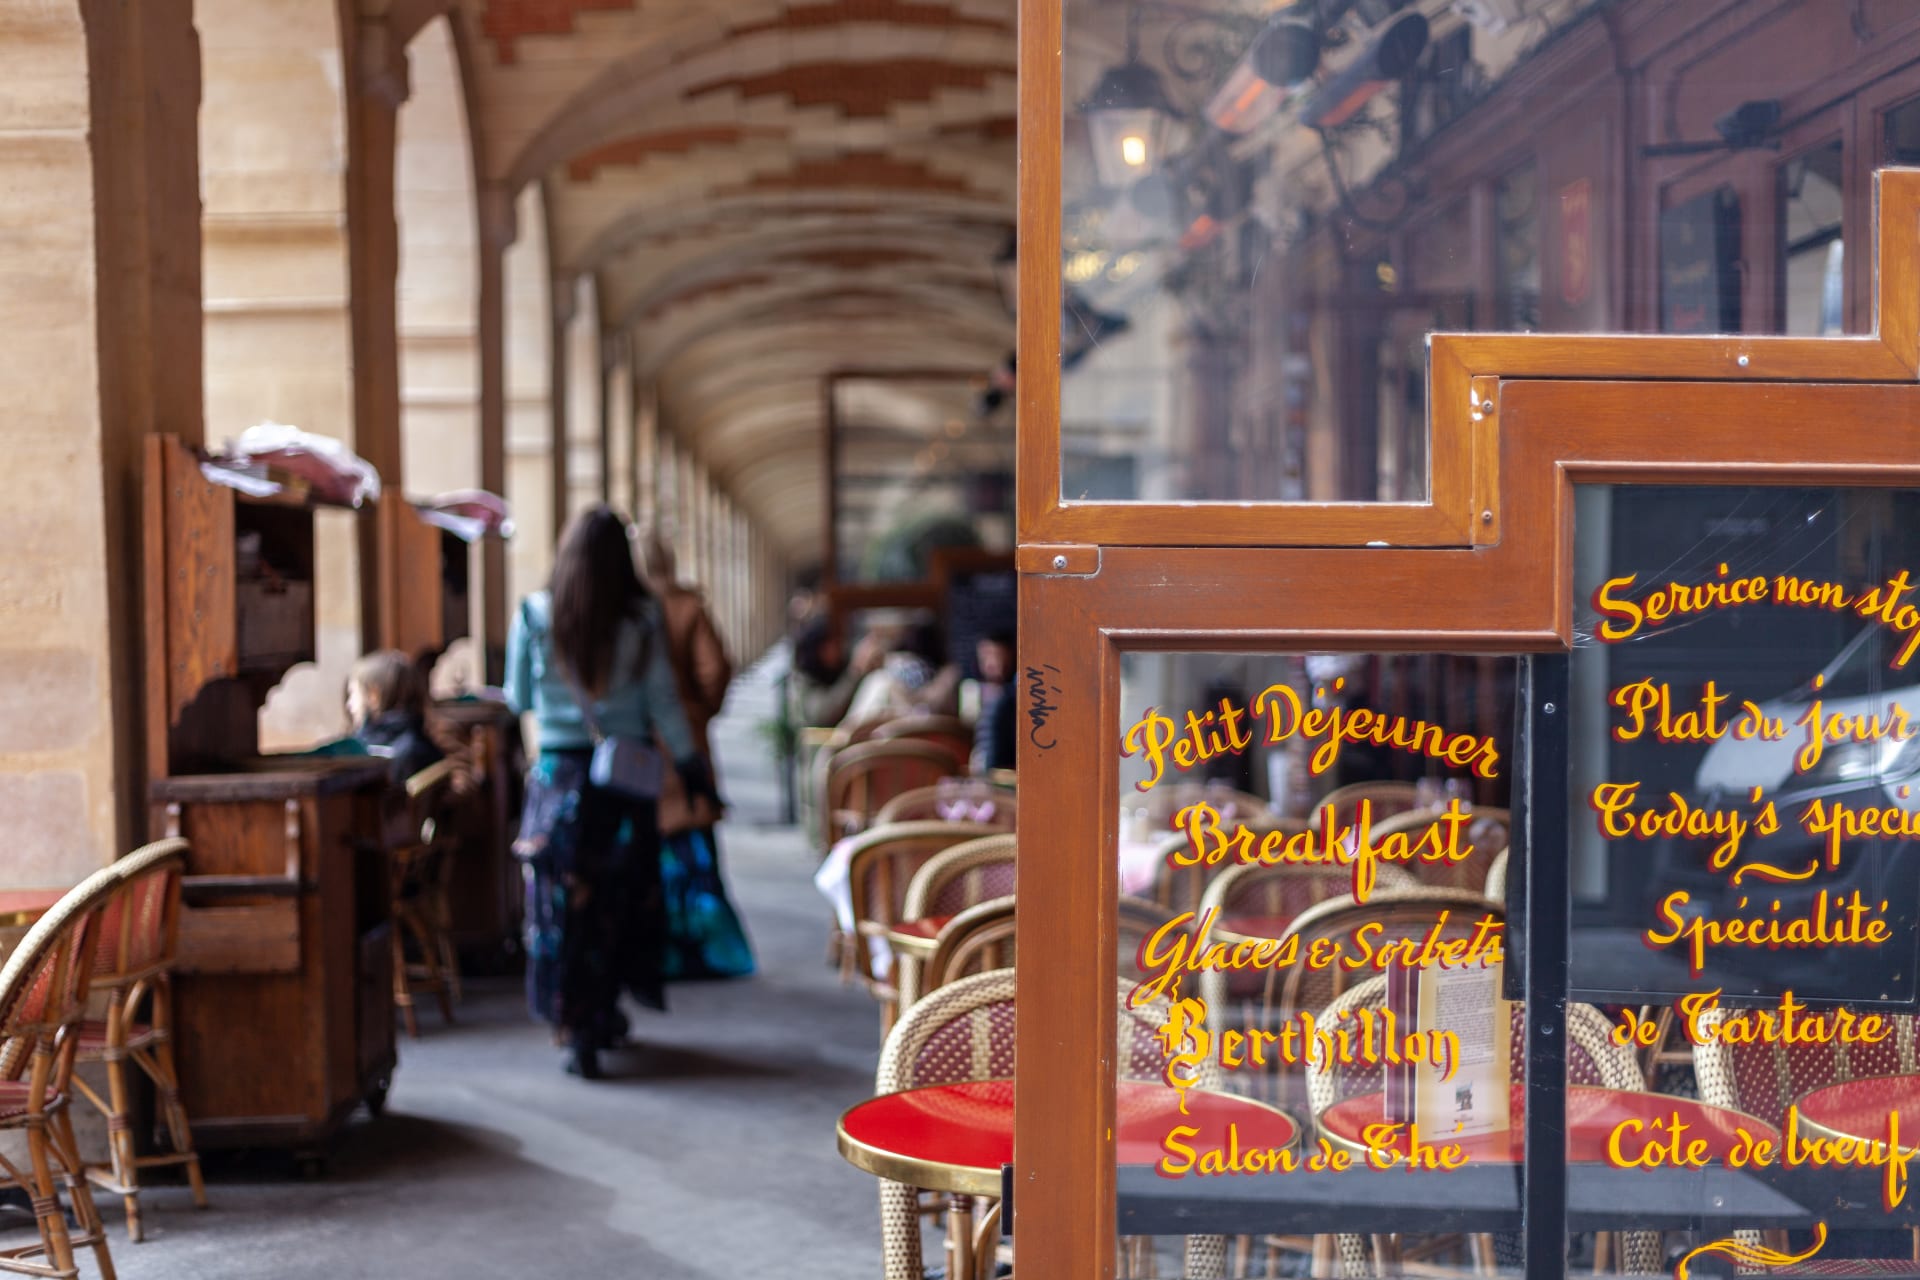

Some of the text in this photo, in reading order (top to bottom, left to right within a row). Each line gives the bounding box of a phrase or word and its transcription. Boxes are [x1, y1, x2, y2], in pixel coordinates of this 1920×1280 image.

[1592, 562, 1769, 643] Service
[1771, 574, 1854, 608] non
[1120, 696, 1252, 793] Petit
[1609, 674, 1917, 775] Plat du jour
[1167, 798, 1475, 905] Breakfast
[1589, 781, 1782, 874] Today's
[1126, 905, 1505, 1010] Glaces & Sorbets
[1641, 889, 1892, 979] Spécialité
[1153, 996, 1460, 1090] Berthillon
[1608, 987, 1893, 1048] de Tartare
[1156, 1122, 1470, 1179] Salon de Thé
[1605, 1111, 1713, 1172] Côte
[1723, 1128, 1776, 1171] de
